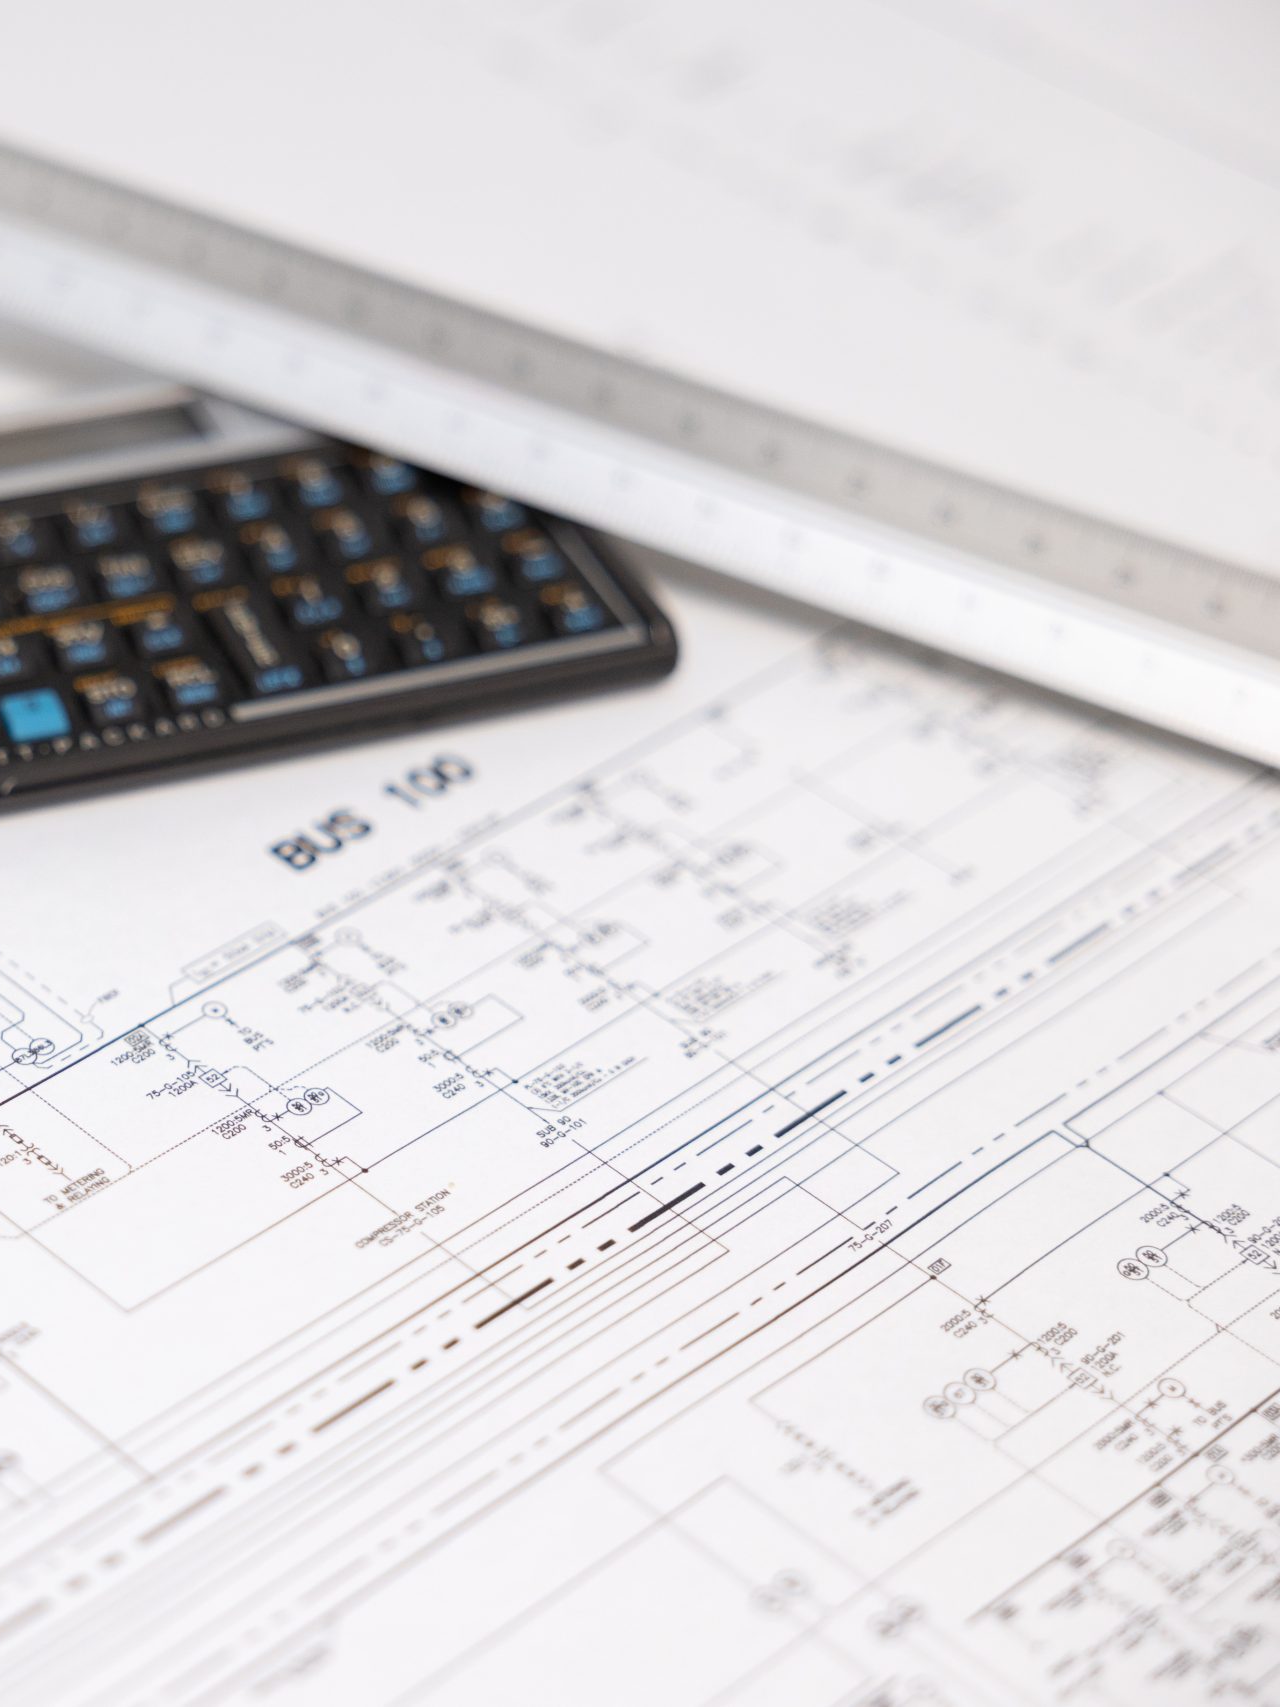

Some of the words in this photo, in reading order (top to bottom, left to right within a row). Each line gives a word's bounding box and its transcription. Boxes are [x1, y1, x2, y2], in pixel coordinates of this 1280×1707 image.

[271, 809, 371, 871] BUS
[384, 755, 474, 808] 100
[205, 1073, 220, 1083] 52
[432, 1072, 464, 1094] 3000:5
[168, 1080, 198, 1098] 1200A
[442, 1083, 466, 1099] C240
[211, 1108, 254, 1135] 1200:5MR
[536, 1124, 557, 1139] SUB
[557, 1115, 572, 1126] 90
[221, 1124, 247, 1141] C200
[268, 1135, 291, 1151] 50:5
[60, 1167, 105, 1195] METERING
[280, 1161, 314, 1184] 3000:5
[289, 1172, 315, 1190] C240
[66, 1176, 111, 1202] RELAYING
[355, 1211, 413, 1249] COMPRESSOR
[414, 1189, 451, 1212] STATION
[1140, 1203, 1170, 1223] 2000:5
[1156, 1211, 1180, 1227] C240
[848, 1219, 893, 1252] 75-G-207
[1248, 1250, 1262, 1260] 52
[940, 1309, 971, 1332] 2000:5
[953, 1320, 977, 1338] C240
